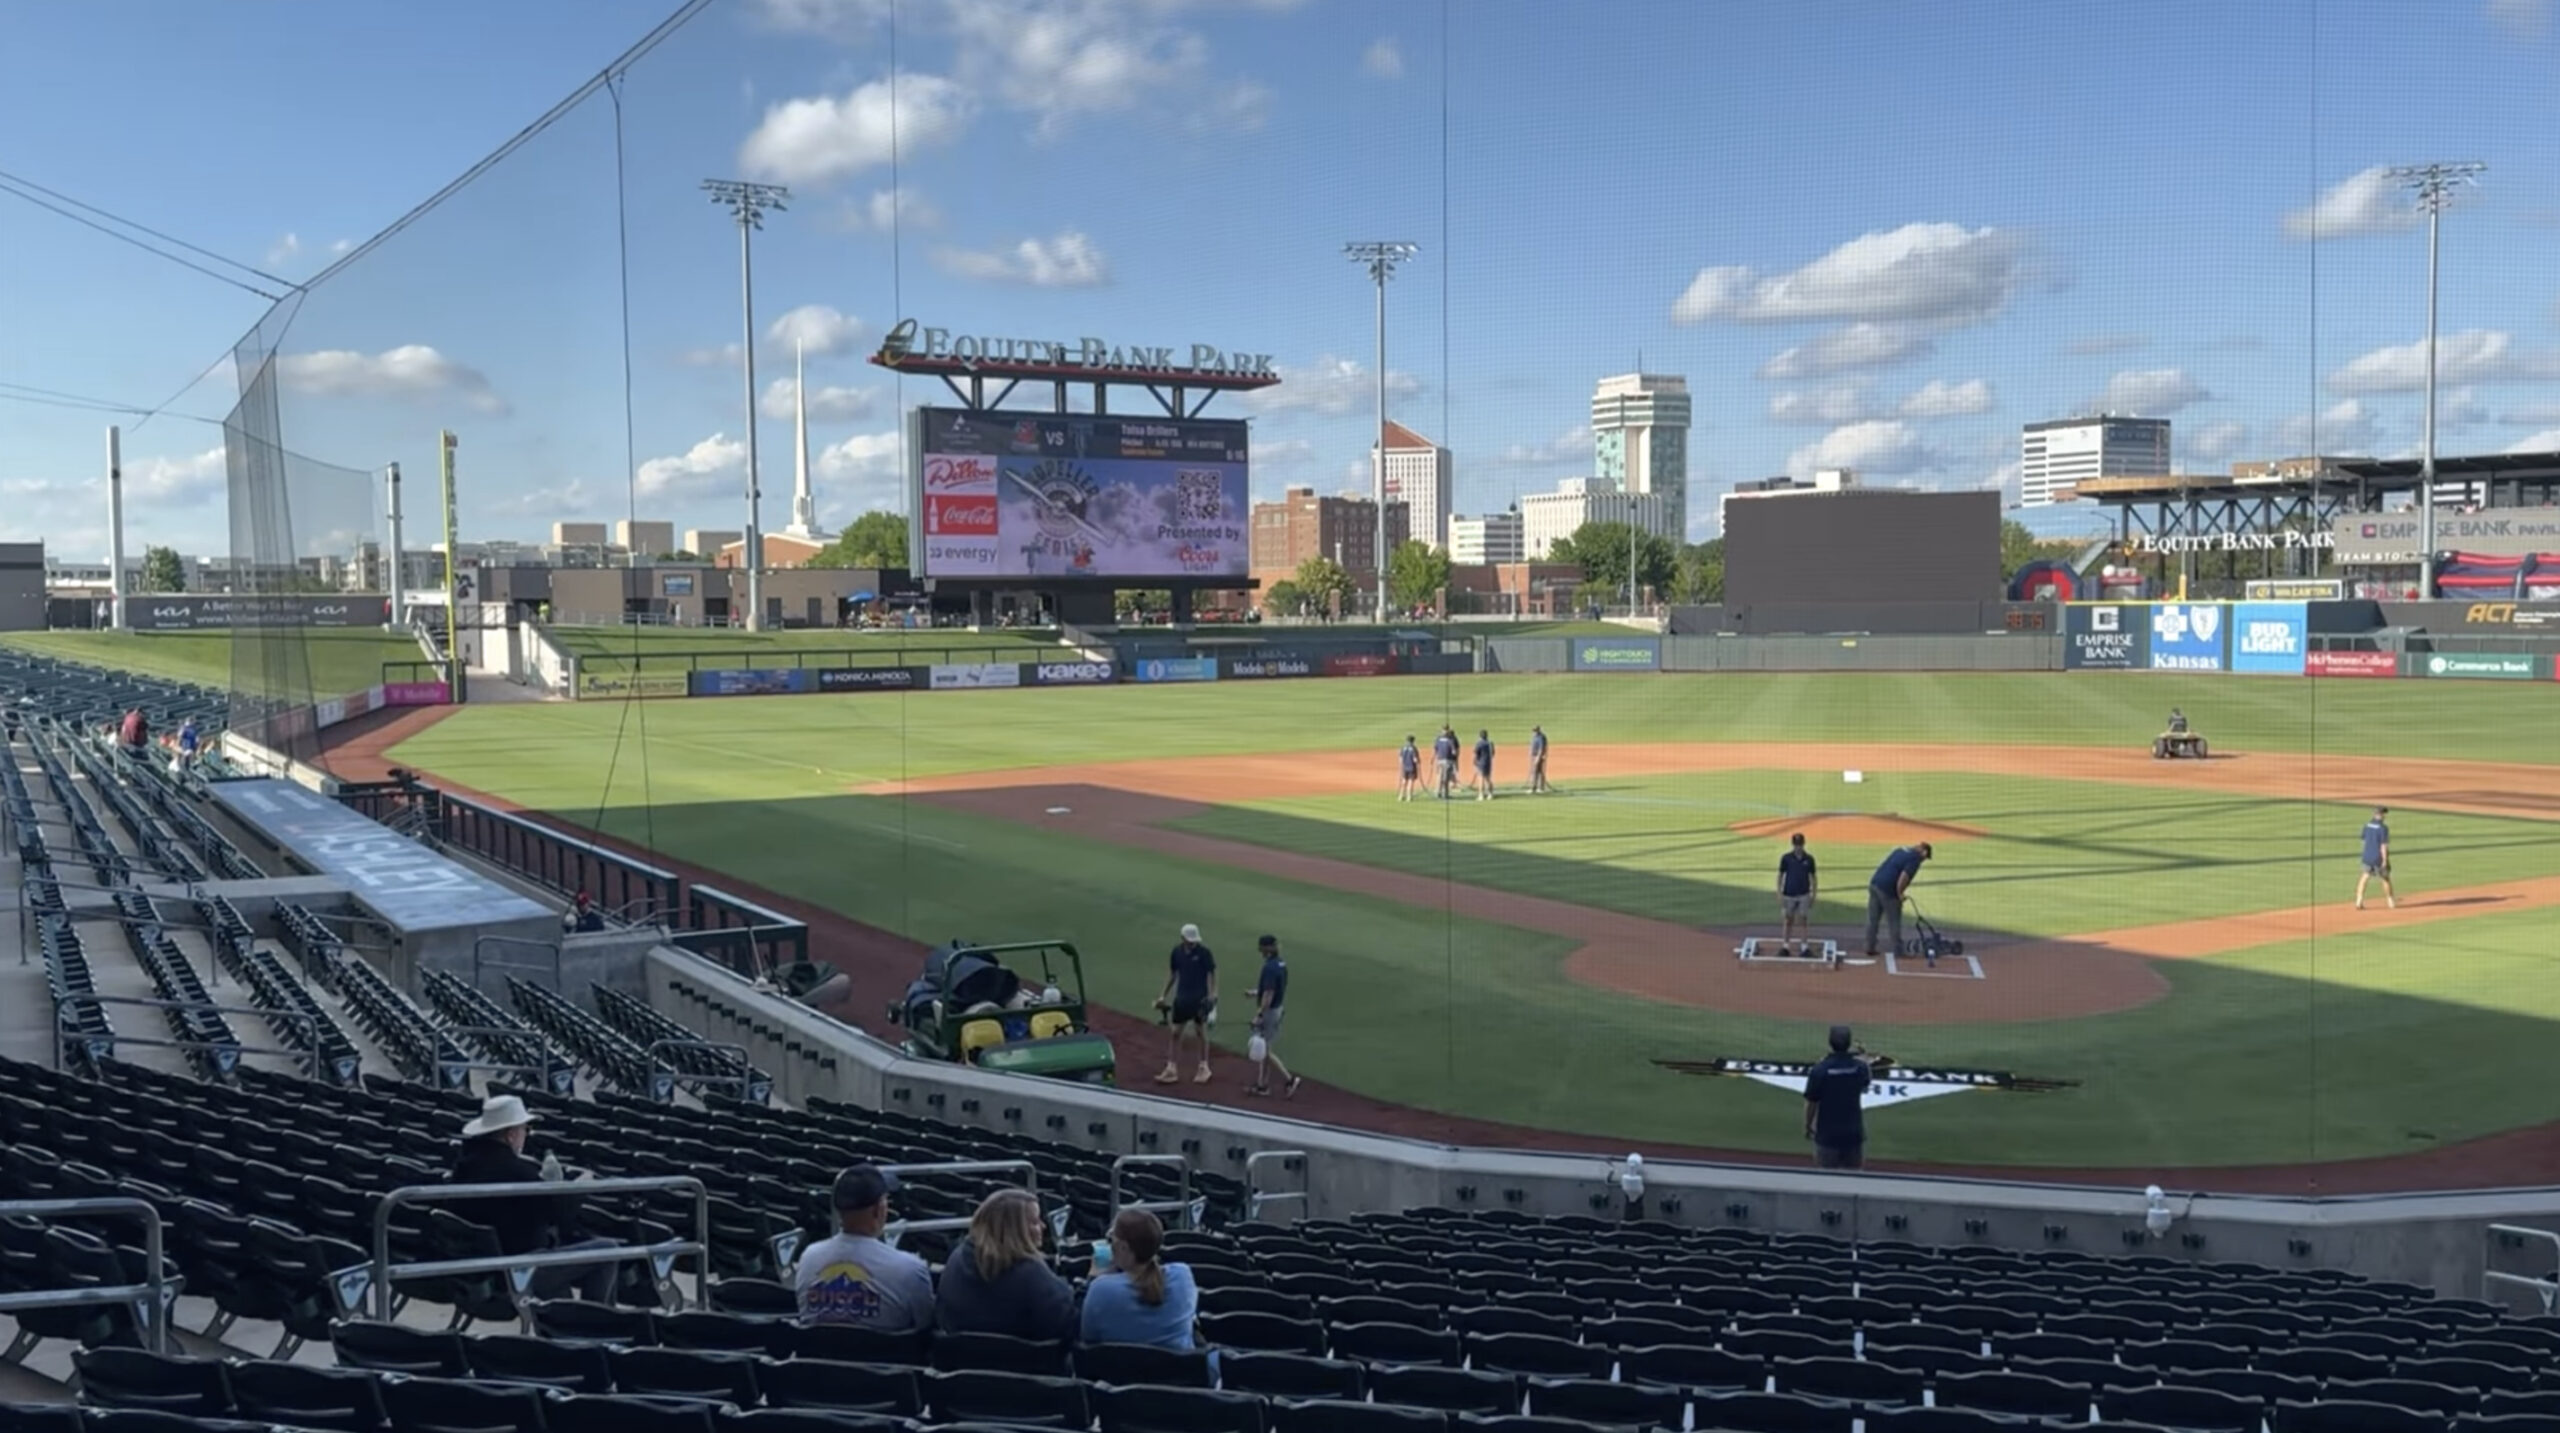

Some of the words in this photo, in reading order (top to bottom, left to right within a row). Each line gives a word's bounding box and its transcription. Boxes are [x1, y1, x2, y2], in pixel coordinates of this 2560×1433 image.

[924, 327, 1067, 371] EQUITY
[1079, 336, 1176, 375] BANK
[1190, 343, 1275, 379] PARK
[1045, 431, 1064, 446] VS
[1158, 525, 1222, 540] Presented
[1226, 526, 1240, 542] by
[2380, 521, 2456, 540] EMPSE
[2460, 520, 2511, 536] BANK
[2144, 535, 2213, 554] EQUITY
[2222, 532, 2275, 550] BANK
[2285, 530, 2334, 548] PARK
[945, 547, 997, 562] evergy
[2336, 552, 2369, 562] TEAM
[2466, 603, 2517, 623] ACT
[2249, 622, 2291, 638] BUD
[2076, 634, 2133, 647] EMPRISE
[2241, 637, 2297, 653] LIGHT
[2085, 647, 2125, 659] BANK
[2154, 654, 2218, 669] Kansas
[2448, 663, 2500, 672] Commerce
[2503, 661, 2529, 672] Bank
[1889, 1070, 1999, 1084] BANK
[808, 1287, 881, 1318] BUSCH
